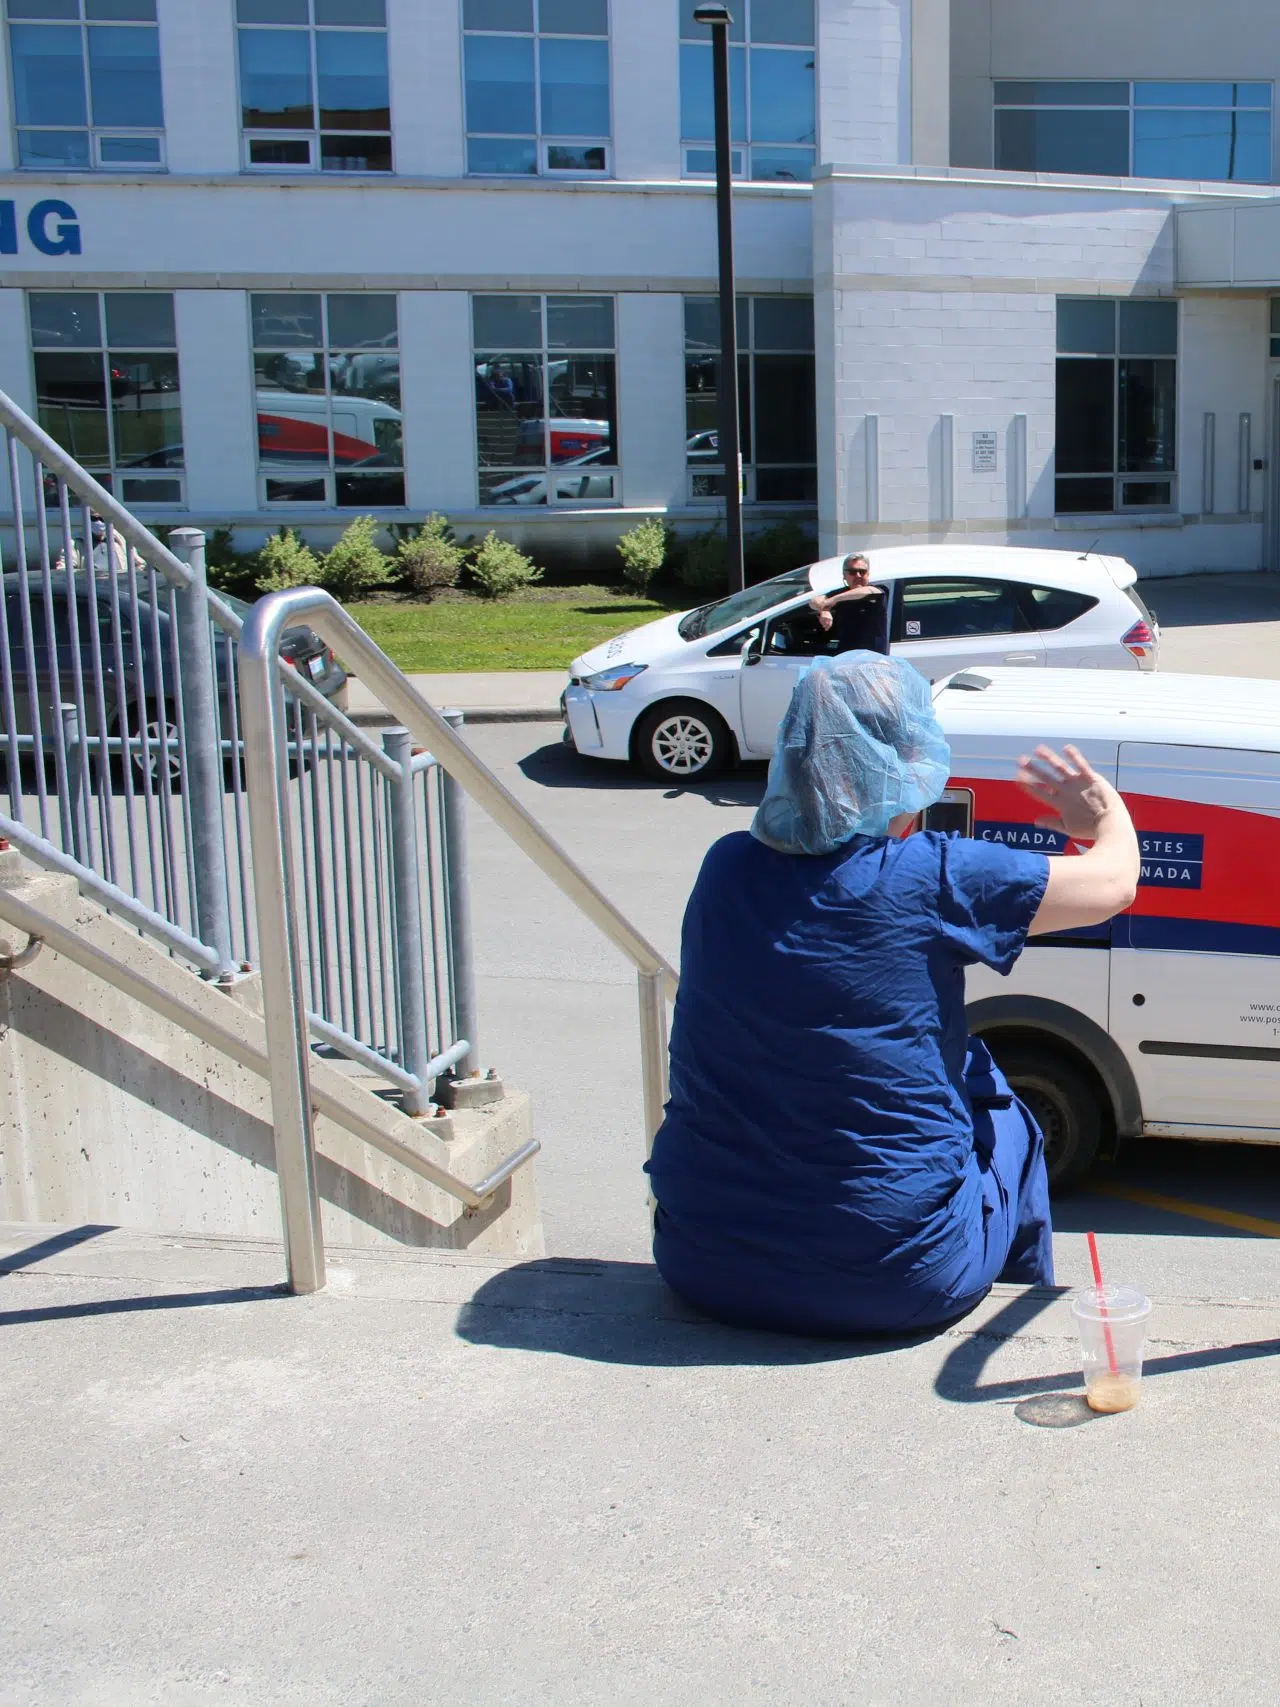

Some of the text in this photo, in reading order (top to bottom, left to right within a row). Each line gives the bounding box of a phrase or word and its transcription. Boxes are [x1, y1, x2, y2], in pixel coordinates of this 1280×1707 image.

[982, 829, 1057, 846] CANADA
[1142, 839, 1184, 854] STES
[1140, 865, 1191, 880] NADA
